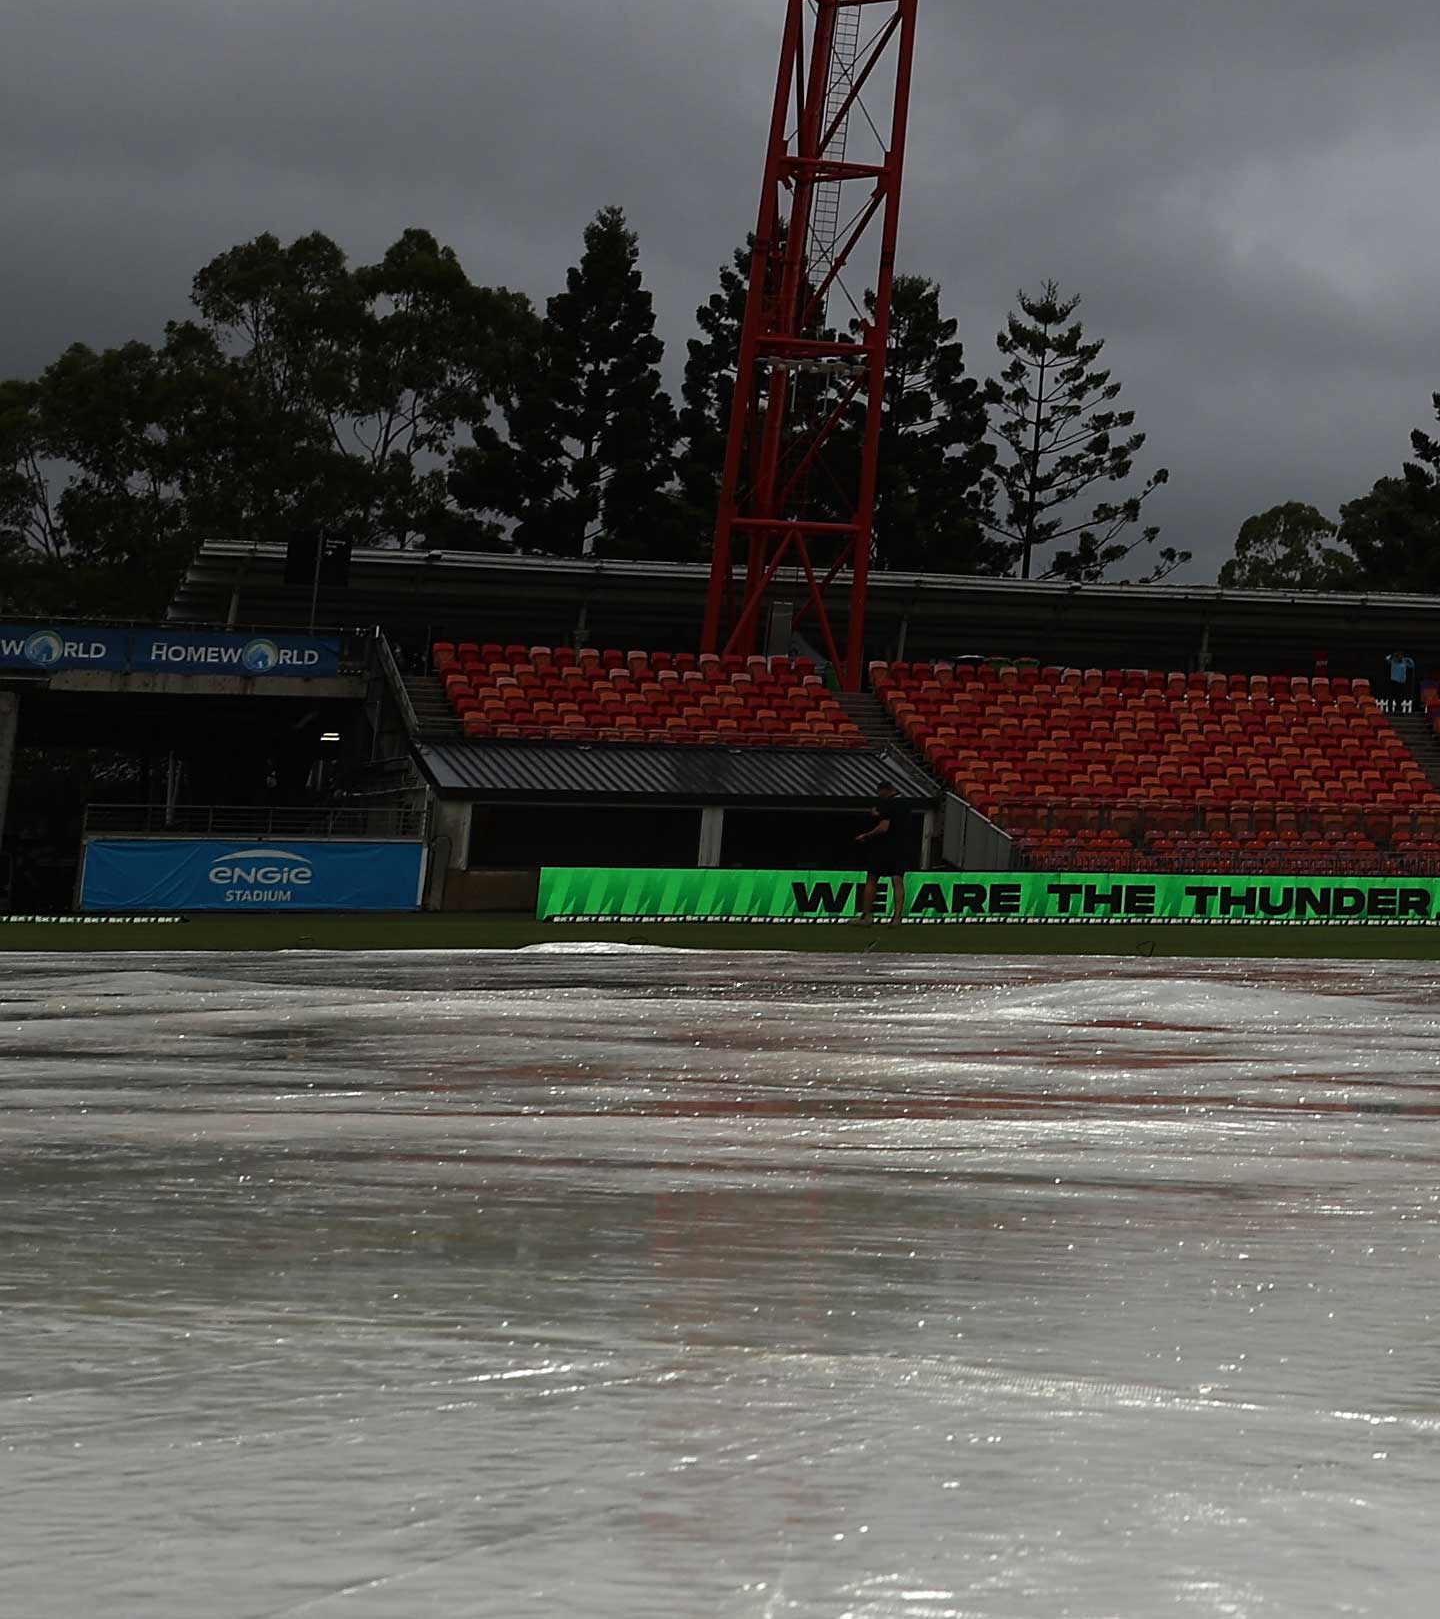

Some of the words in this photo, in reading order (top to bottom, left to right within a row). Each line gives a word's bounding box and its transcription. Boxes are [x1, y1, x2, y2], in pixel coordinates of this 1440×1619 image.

[224, 890, 291, 902] STADIUM
[792, 882, 888, 912] WE
[911, 884, 1021, 913] ARE
[1047, 884, 1155, 913] THE
[1185, 887, 1430, 916] THUNDER
